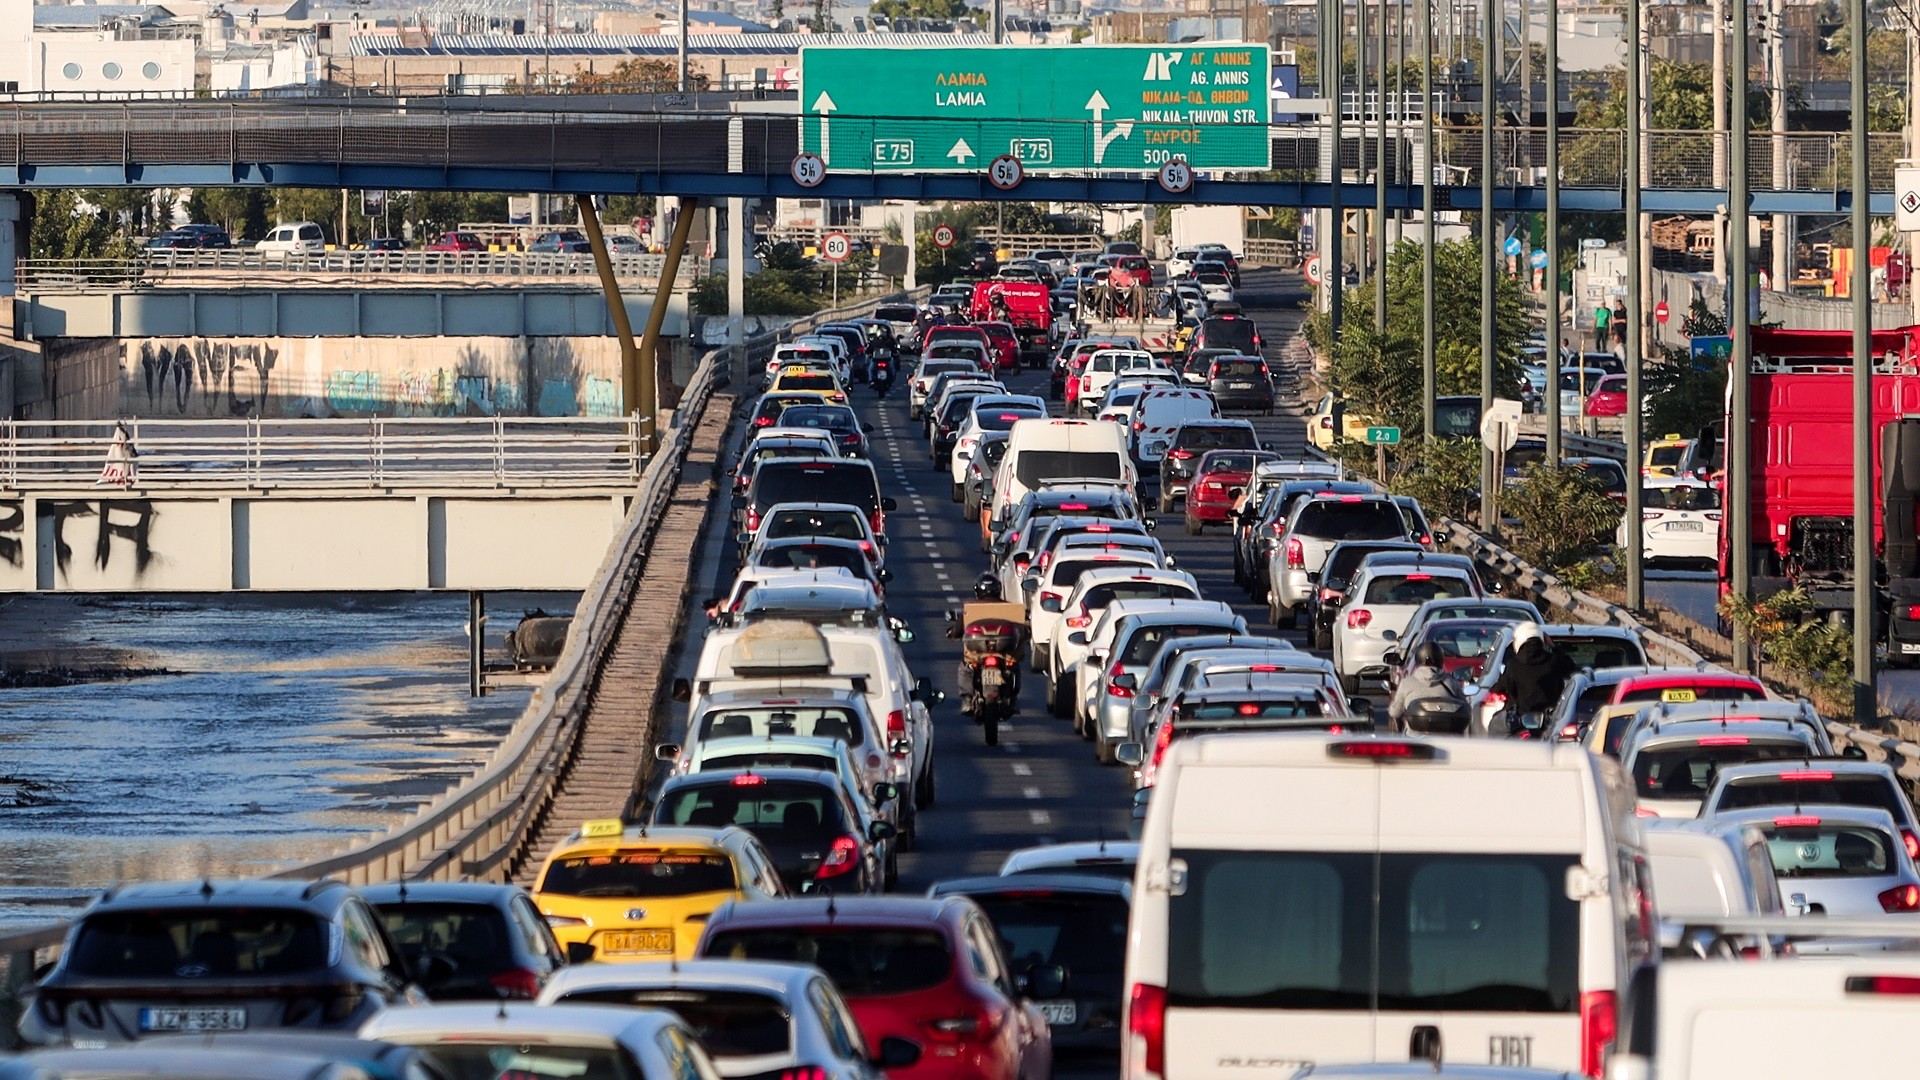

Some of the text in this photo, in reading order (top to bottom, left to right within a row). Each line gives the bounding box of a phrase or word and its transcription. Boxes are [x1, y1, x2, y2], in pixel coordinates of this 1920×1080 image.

[1213, 51, 1251, 65] ΑΝΝΗΣ
[1190, 71, 1249, 85] AG. ANNIS
[935, 91, 987, 106] LAMIA
[1142, 109, 1259, 123] NIKAIA-THIVON STR.
[876, 144, 910, 160] E 75
[1014, 143, 1048, 159] E 75
[938, 231, 950, 241] 80
[828, 241, 844, 252] 80
[1668, 692, 1691, 700] TAXI
[1489, 1036, 1535, 1066] FIAT
